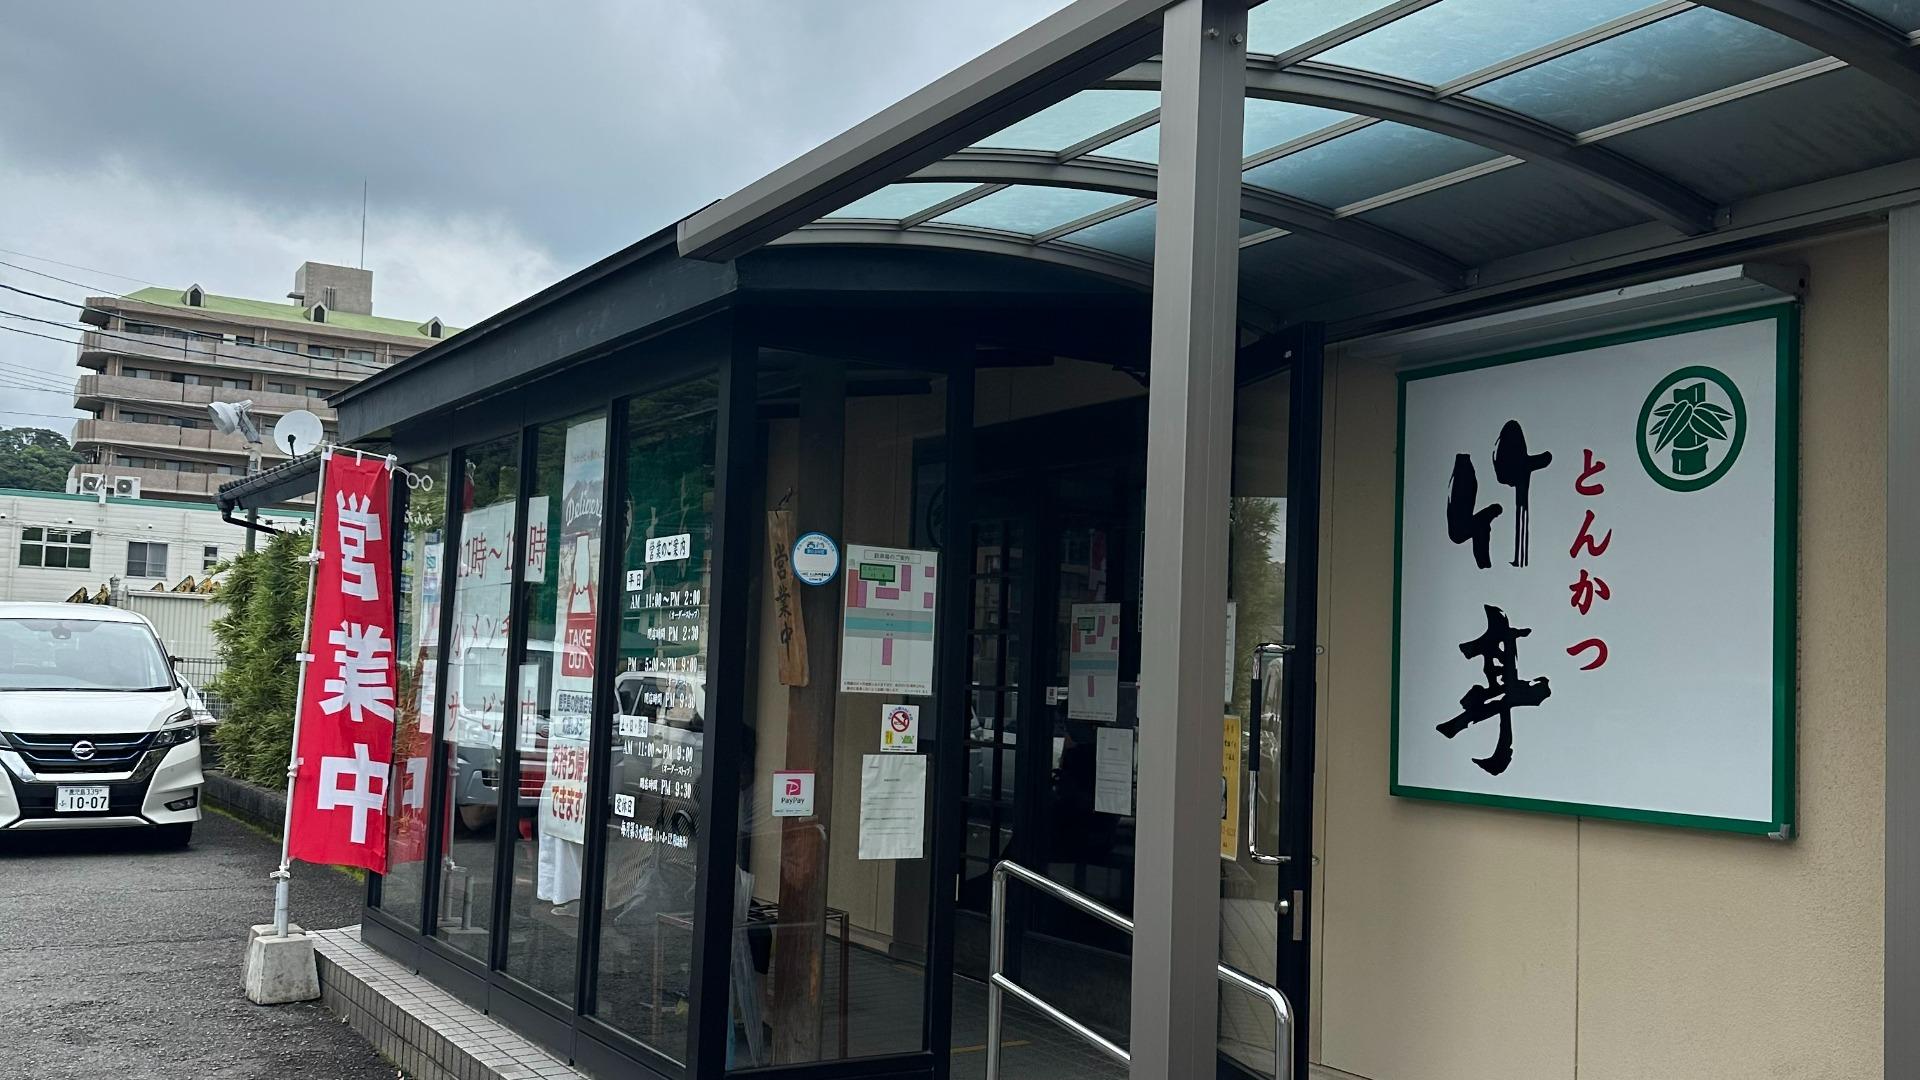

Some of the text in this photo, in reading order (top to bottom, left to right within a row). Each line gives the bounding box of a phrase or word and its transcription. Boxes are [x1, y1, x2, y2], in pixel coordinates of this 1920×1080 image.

[649, 537, 686, 561] 営業のご案内
[1566, 448, 1613, 671] とんかつ
[628, 573, 642, 587] 平日
[630, 594, 641, 609] AM
[684, 589, 701, 606] 2:00
[774, 543, 794, 660] 営業中
[1435, 419, 1552, 776] 竹亭
[568, 628, 592, 647] TAKE
[668, 626, 679, 642] PM
[682, 625, 699, 641] 2:30
[317, 489, 394, 845] 営業中
[568, 652, 586, 669] OUT
[627, 657, 637, 671] PM
[681, 657, 698, 672] 9:00
[665, 692, 676, 708] PM
[679, 692, 696, 709] 9:30
[623, 740, 634, 755] AM
[677, 746, 693, 762] 9:00
[661, 779, 671, 796] PM
[675, 781, 692, 798] 9:30
[70, 796, 107, 809] 10-07
[616, 798, 633, 813] 定休日
[781, 797, 805, 805] PayPay
